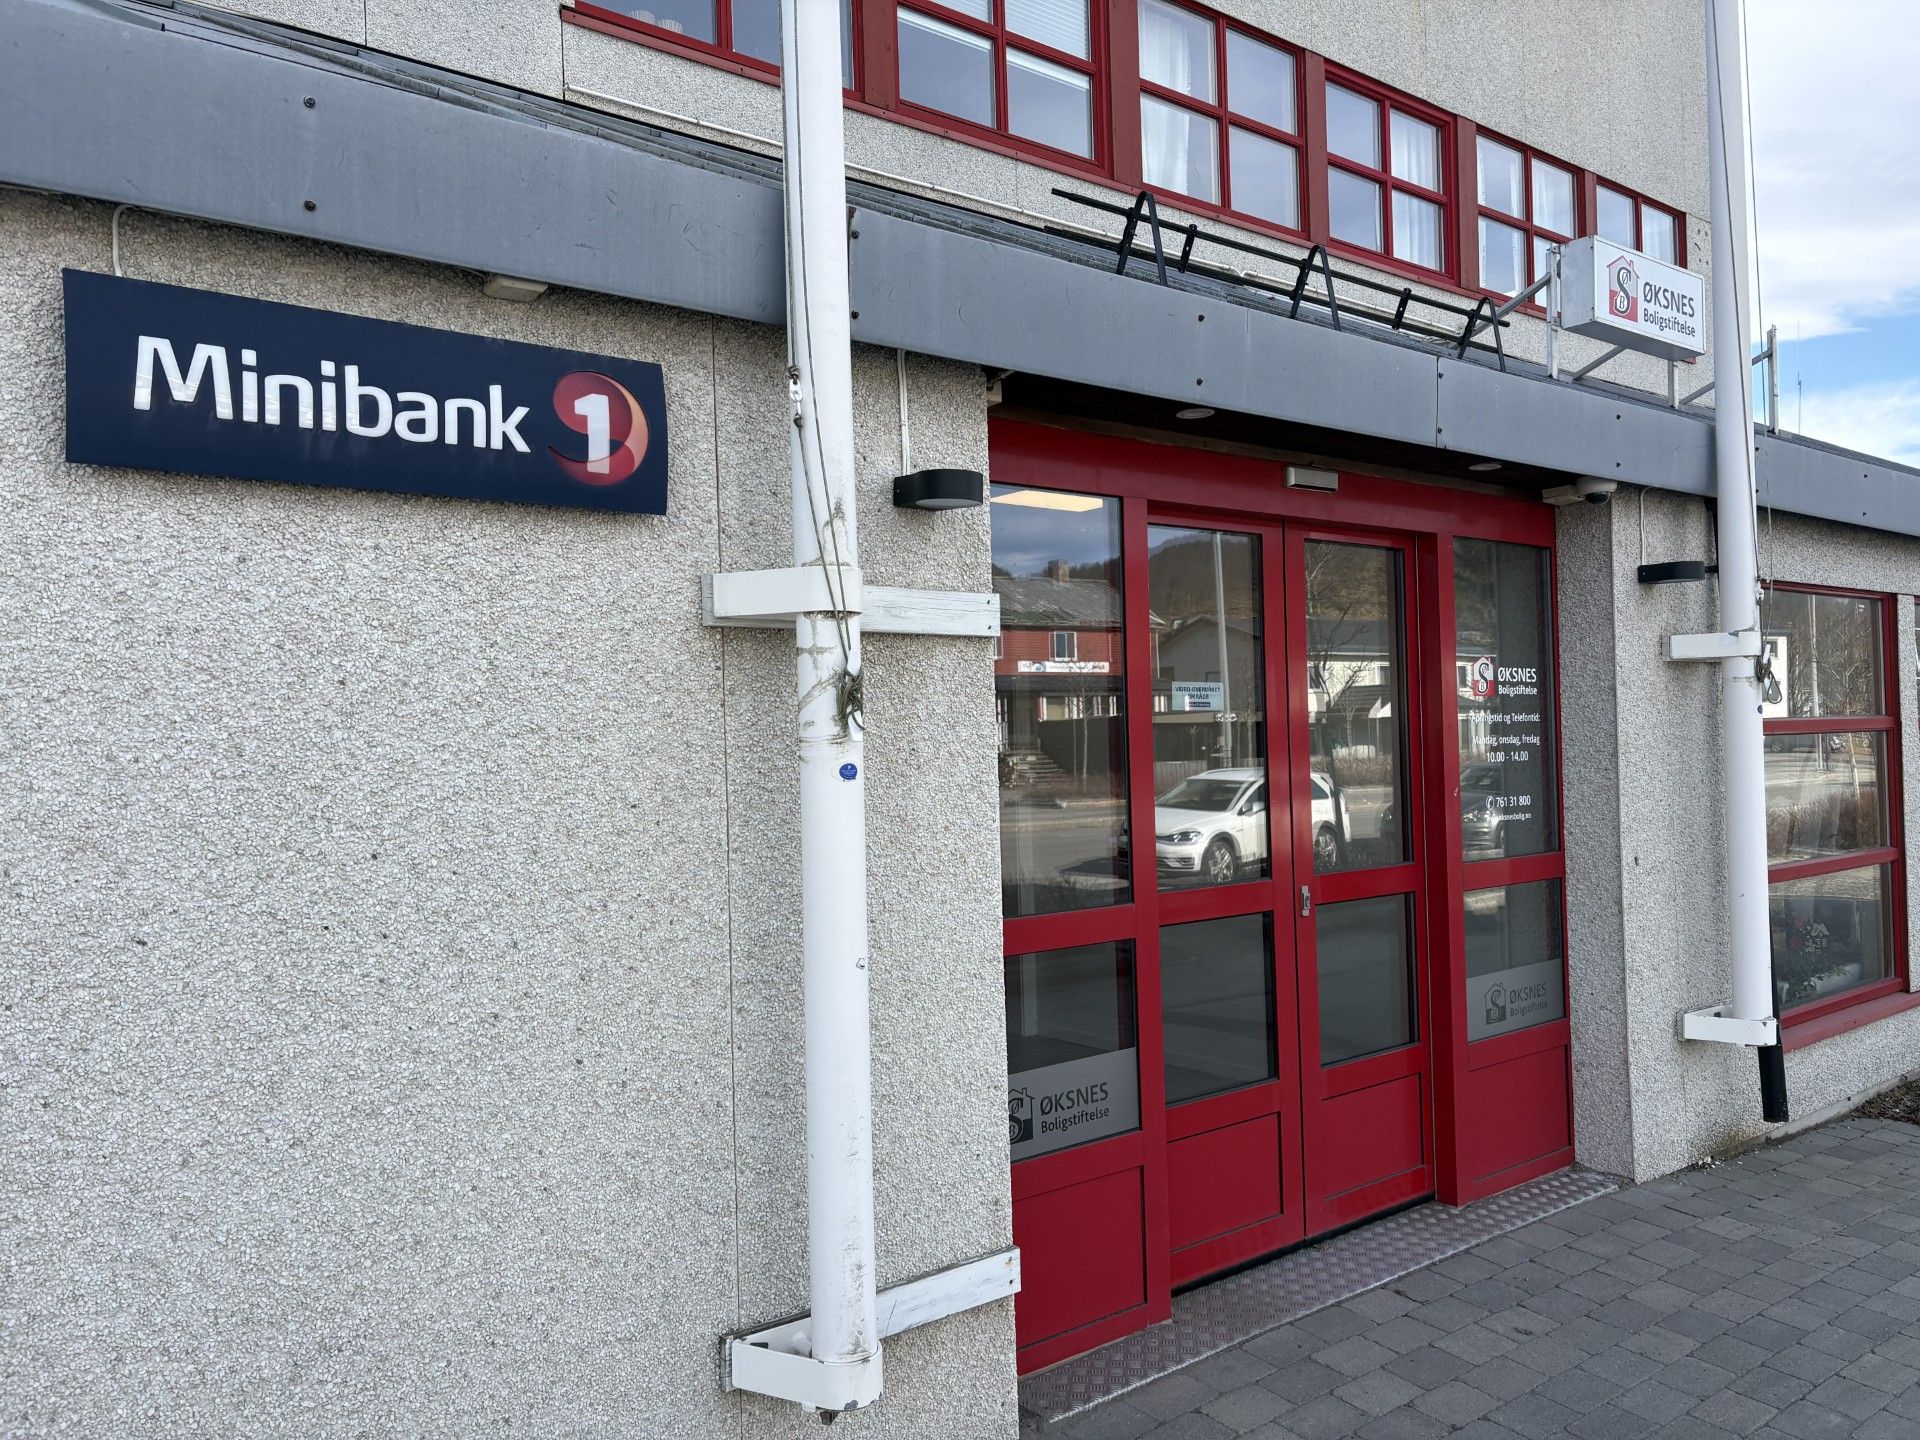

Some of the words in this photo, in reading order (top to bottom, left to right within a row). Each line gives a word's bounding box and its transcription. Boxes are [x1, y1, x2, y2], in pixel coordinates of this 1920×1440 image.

[1643, 281, 1695, 318] ØKSNES
[1643, 308, 1696, 338] Boligstiftelse
[133, 335, 531, 453] Minibank
[1497, 667, 1537, 683] ØKSNES
[1498, 684, 1538, 697] Boligstiftelse
[1503, 714, 1511, 725] og
[1511, 712, 1541, 722] Telefontid:
[1521, 733, 1541, 746] fredag
[1486, 751, 1505, 763] 10.00
[1510, 750, 1529, 762] 14.00
[1495, 796, 1508, 808] 761
[1509, 796, 1517, 807] 31
[1518, 795, 1531, 806] 800
[1509, 982, 1547, 1005] ØKSNES
[1040, 1082, 1109, 1117] ØKSNES
[1041, 1106, 1110, 1134] Boligstiftelse
